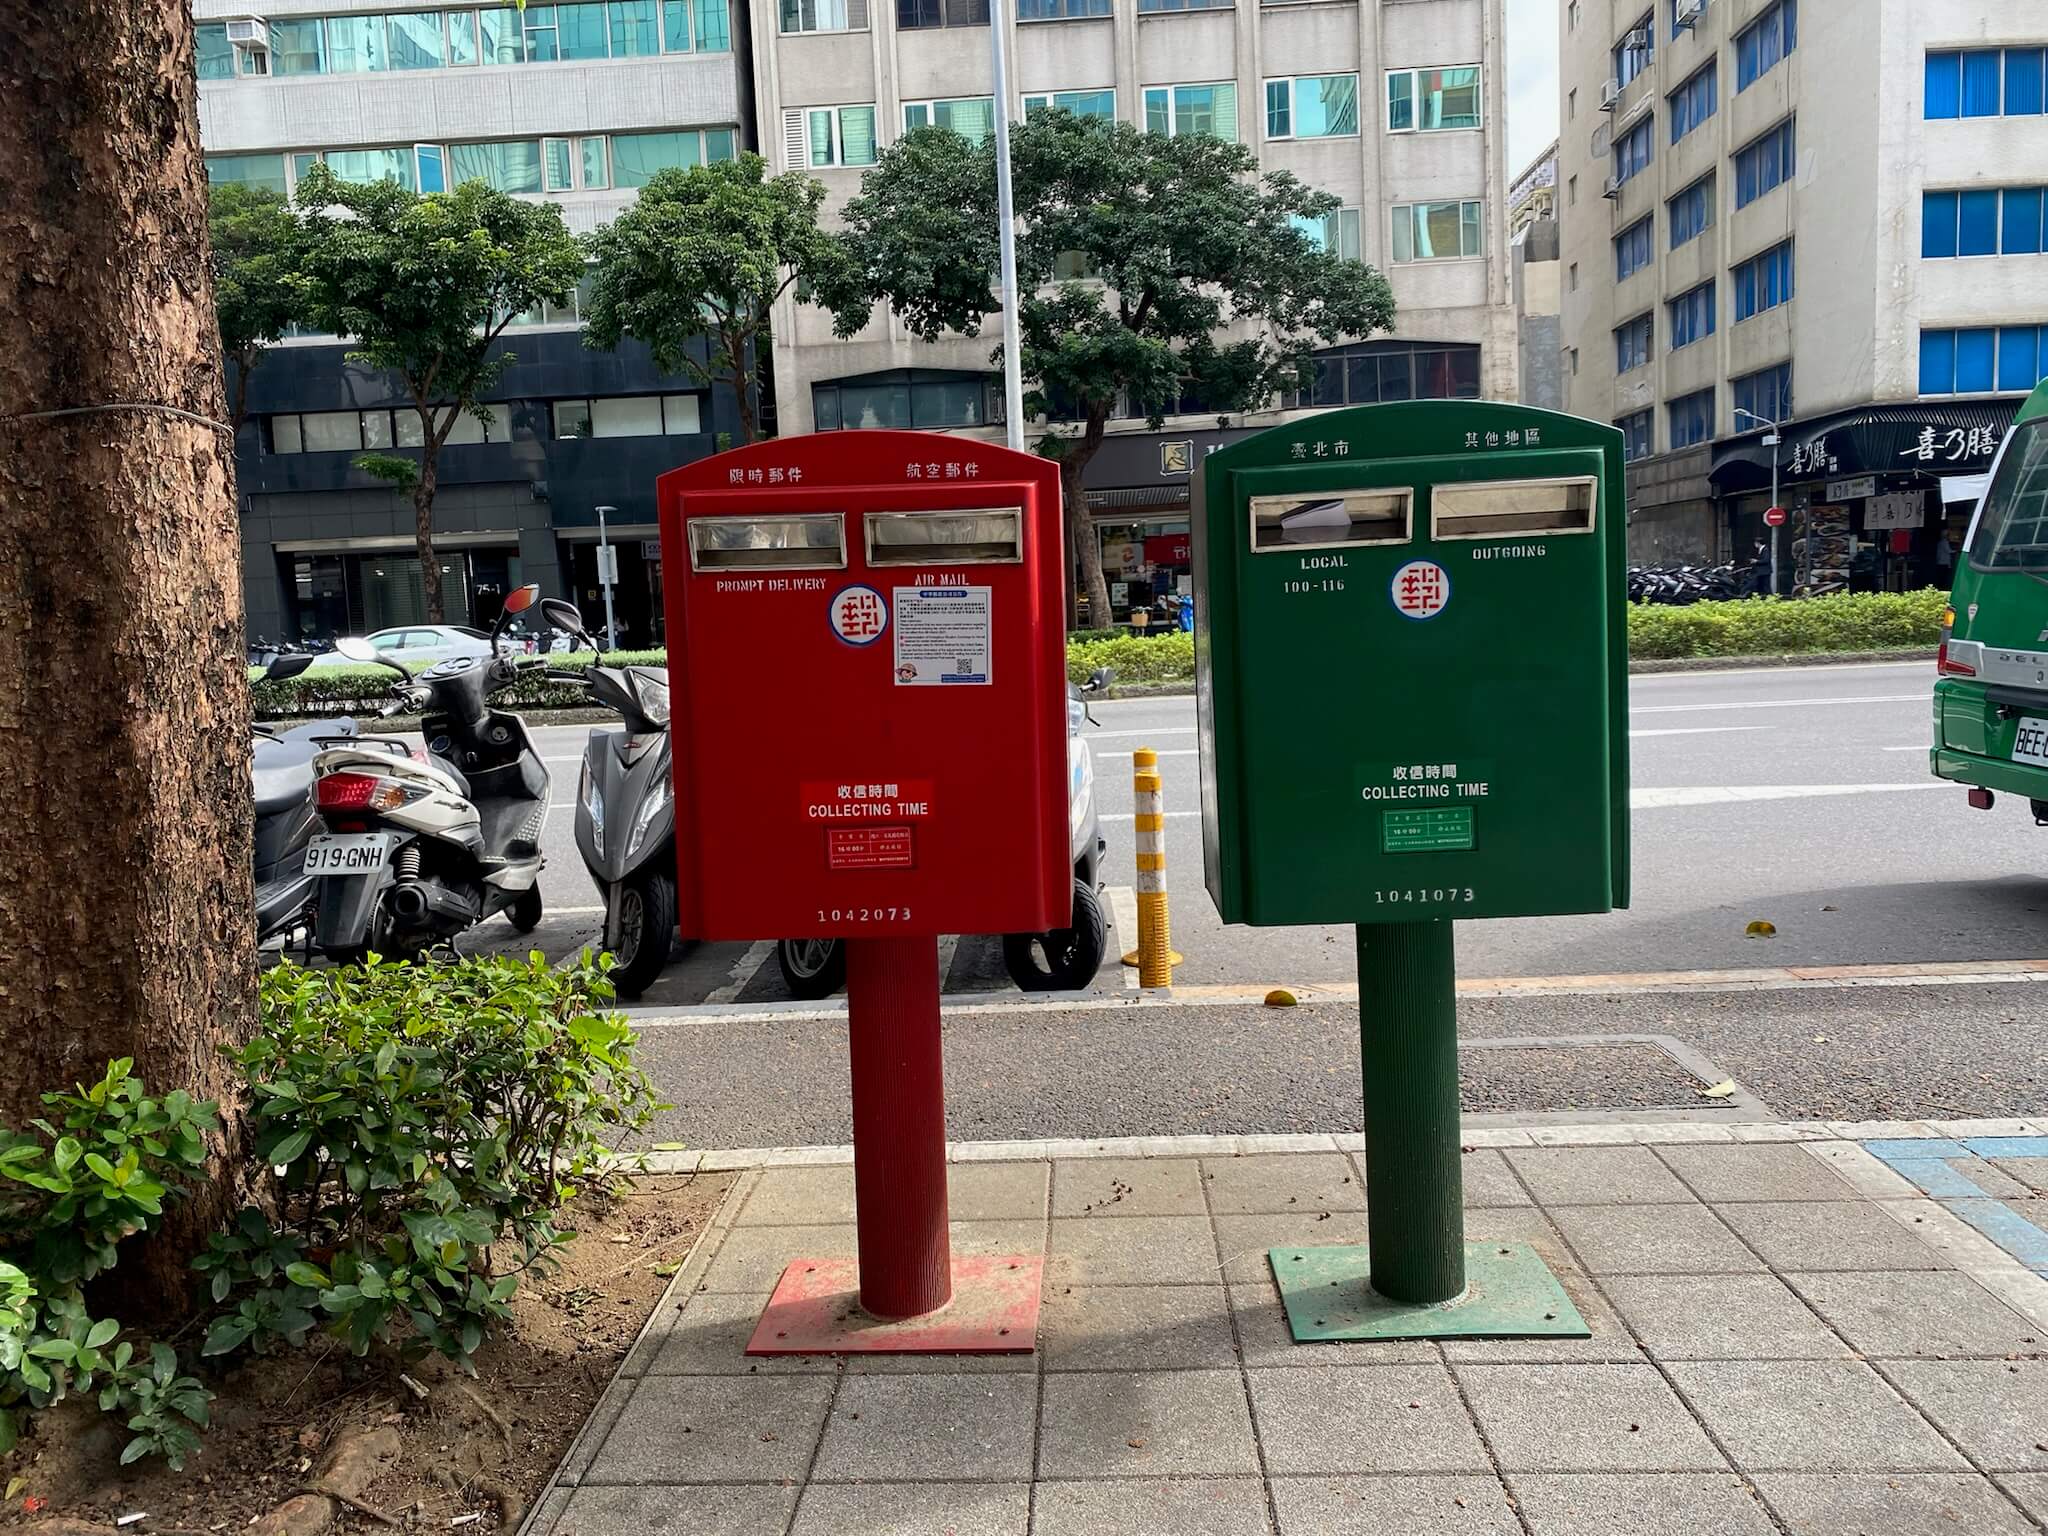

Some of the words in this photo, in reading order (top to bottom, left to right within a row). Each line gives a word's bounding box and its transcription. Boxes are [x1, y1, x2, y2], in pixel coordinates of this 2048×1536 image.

[1465, 428, 1541, 447] 其他地區
[1899, 423, 2000, 461] 喜乃膳
[1291, 440, 1350, 459] 臺北市
[729, 466, 802, 484] 限時郵件
[906, 461, 979, 478] 航空郵件
[1472, 544, 1546, 560] OUTGOING
[1301, 555, 1349, 570] LOCAL
[716, 579, 764, 592] PROMPT
[768, 577, 827, 591] DELIVERY
[915, 573, 935, 586] AIR
[940, 573, 970, 586] MAIL
[1284, 579, 1345, 593] 100-116
[1393, 764, 1457, 780] 收信時間
[837, 783, 899, 799] 收信時間
[1362, 784, 1450, 800] COLLECTING
[1456, 782, 1489, 796] TIME
[808, 803, 892, 818] COLLECTING
[897, 802, 929, 815] TIME
[1375, 888, 1475, 904] 1041073
[817, 907, 912, 922] 1042073
